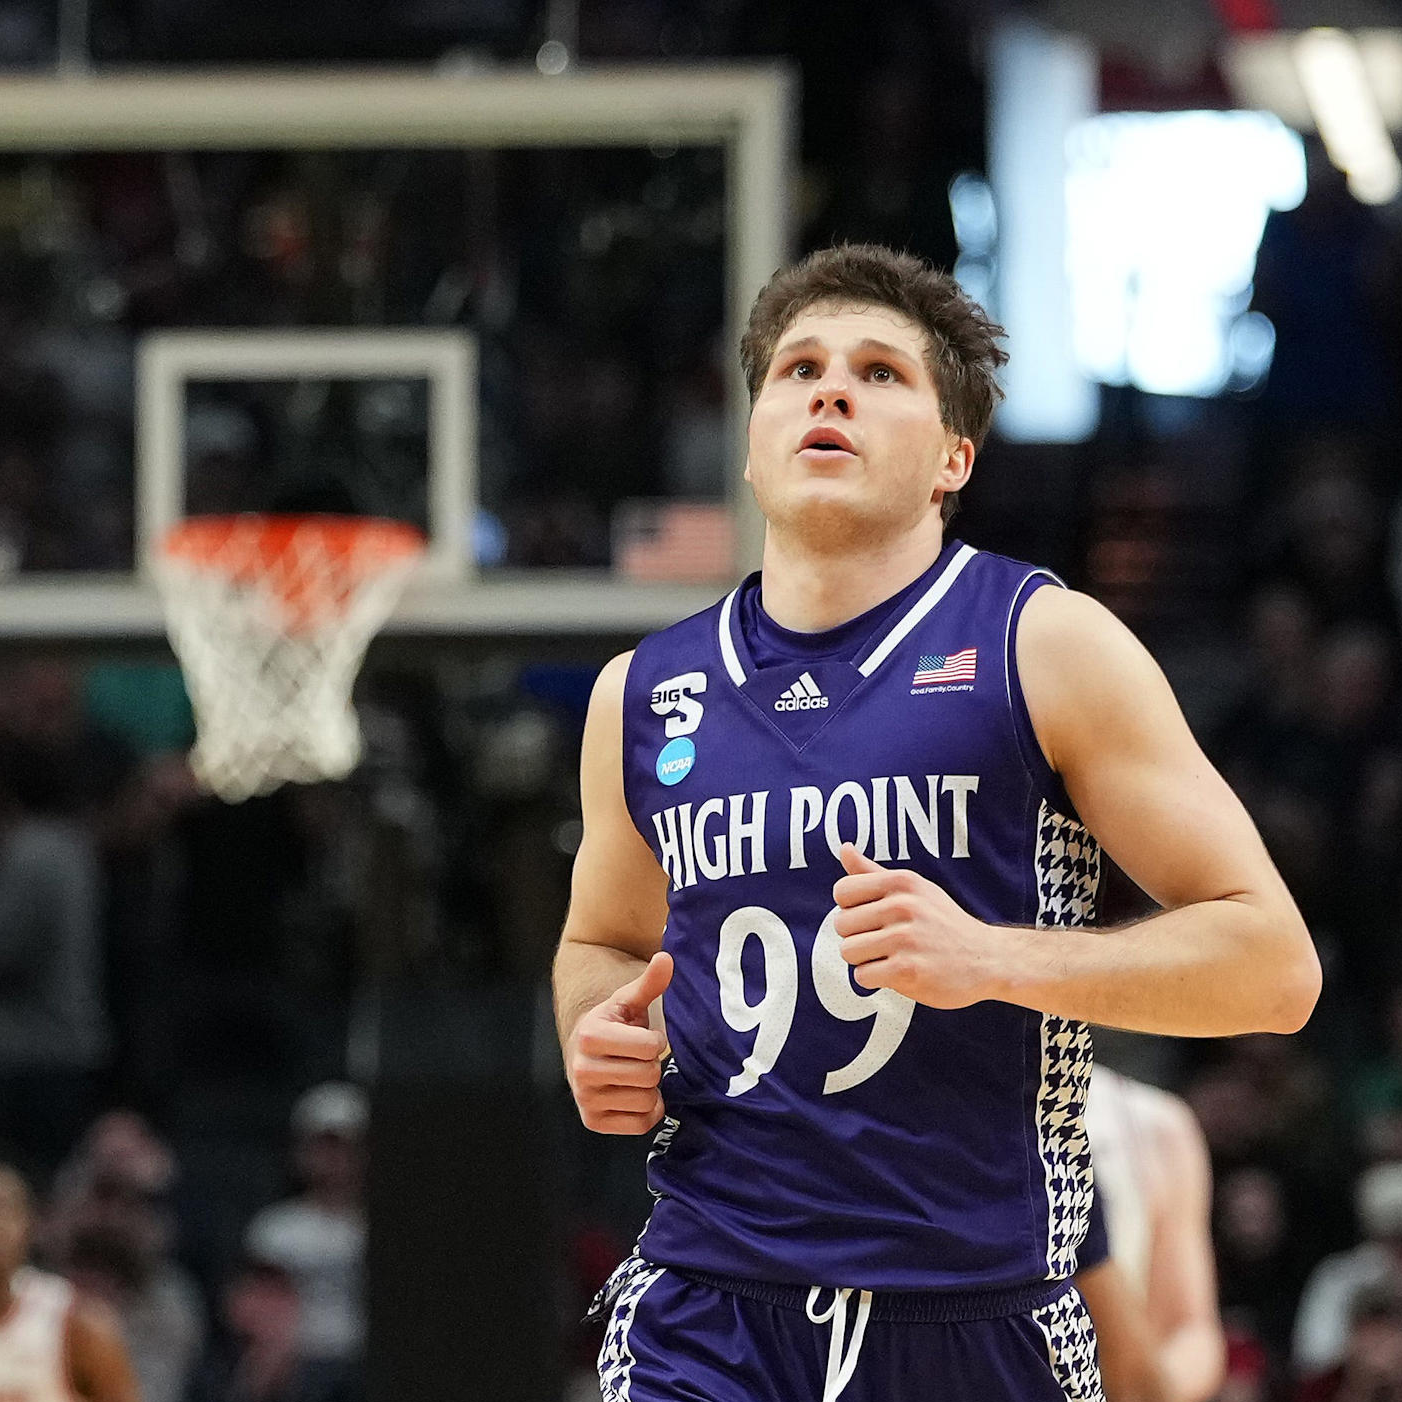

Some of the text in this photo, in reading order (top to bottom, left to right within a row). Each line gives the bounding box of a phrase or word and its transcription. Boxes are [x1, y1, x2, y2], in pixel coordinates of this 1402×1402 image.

[774, 696, 829, 711] adidas
[661, 757, 693, 775] NCAA
[651, 775, 980, 892] HIGH POINT
[715, 906, 917, 1097] 99
